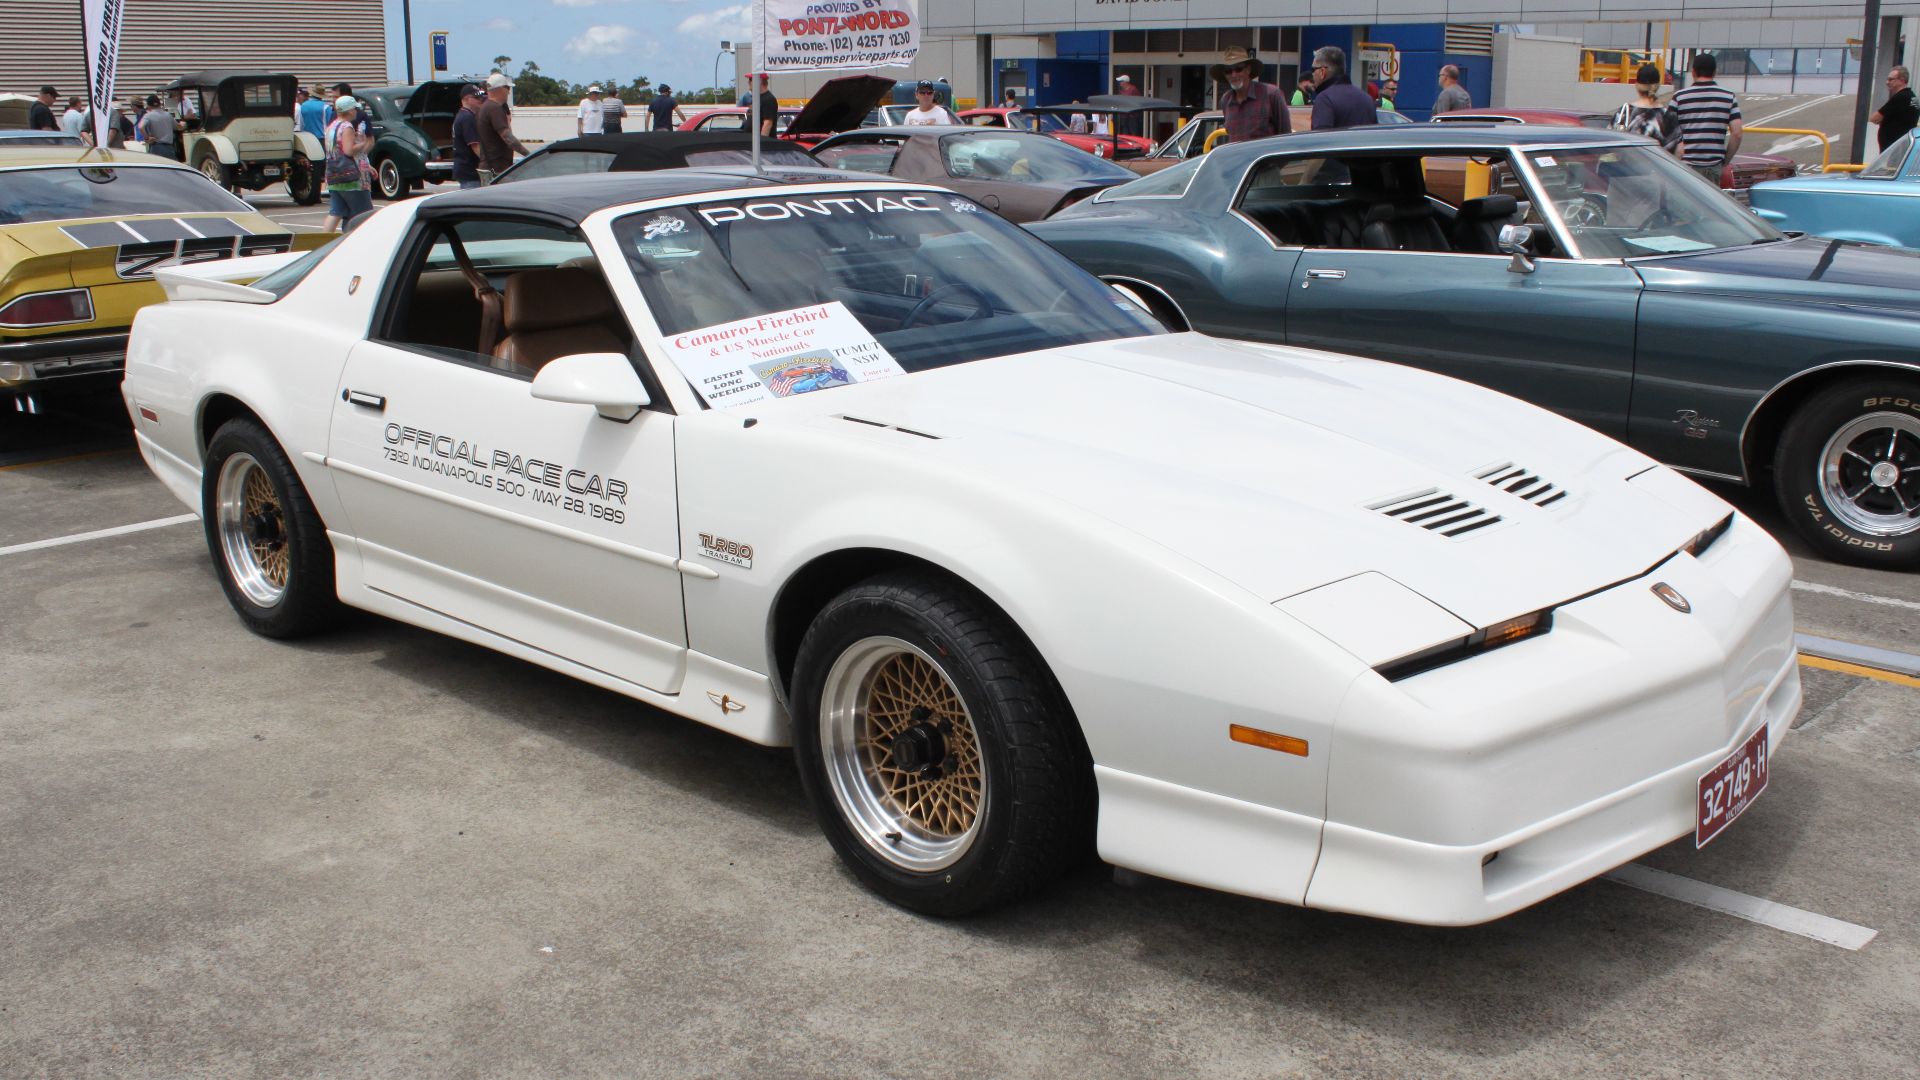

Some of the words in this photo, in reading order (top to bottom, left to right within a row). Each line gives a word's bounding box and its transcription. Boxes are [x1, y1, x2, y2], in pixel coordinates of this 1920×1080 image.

[807, 0, 860, 15] PROVIDED
[110, 42, 115, 55] of
[784, 40, 826, 51] Phone:
[831, 37, 853, 52] (02)
[857, 35, 884, 48] 4257
[889, 31, 910, 47] 1230
[94, 41, 108, 110] CAMARO
[106, 54, 114, 79] Club
[102, 79, 111, 116] Owners
[698, 197, 940, 226] PONTIAC
[674, 307, 830, 349] Camaro-Firebird
[710, 347, 721, 358] &
[724, 341, 745, 354] US
[747, 331, 791, 348] Muscle
[794, 327, 816, 339] Car
[752, 340, 811, 360] Nationals
[833, 341, 879, 357] TUMUT
[852, 353, 880, 364] NSW
[703, 369, 744, 384] EASTER
[713, 377, 742, 390] LONG
[708, 381, 761, 400] WEEKEND
[385, 422, 488, 469] OFFICIAL
[492, 449, 563, 488] PACE
[565, 469, 628, 505] CAR
[383, 447, 409, 465] 73RD
[413, 455, 493, 488] INDIANAPOLIS
[496, 478, 525, 497] 500
[532, 488, 562, 507] MAY
[699, 533, 753, 560] TURBO
[705, 549, 729, 561] TRANS
[731, 557, 743, 565] AM
